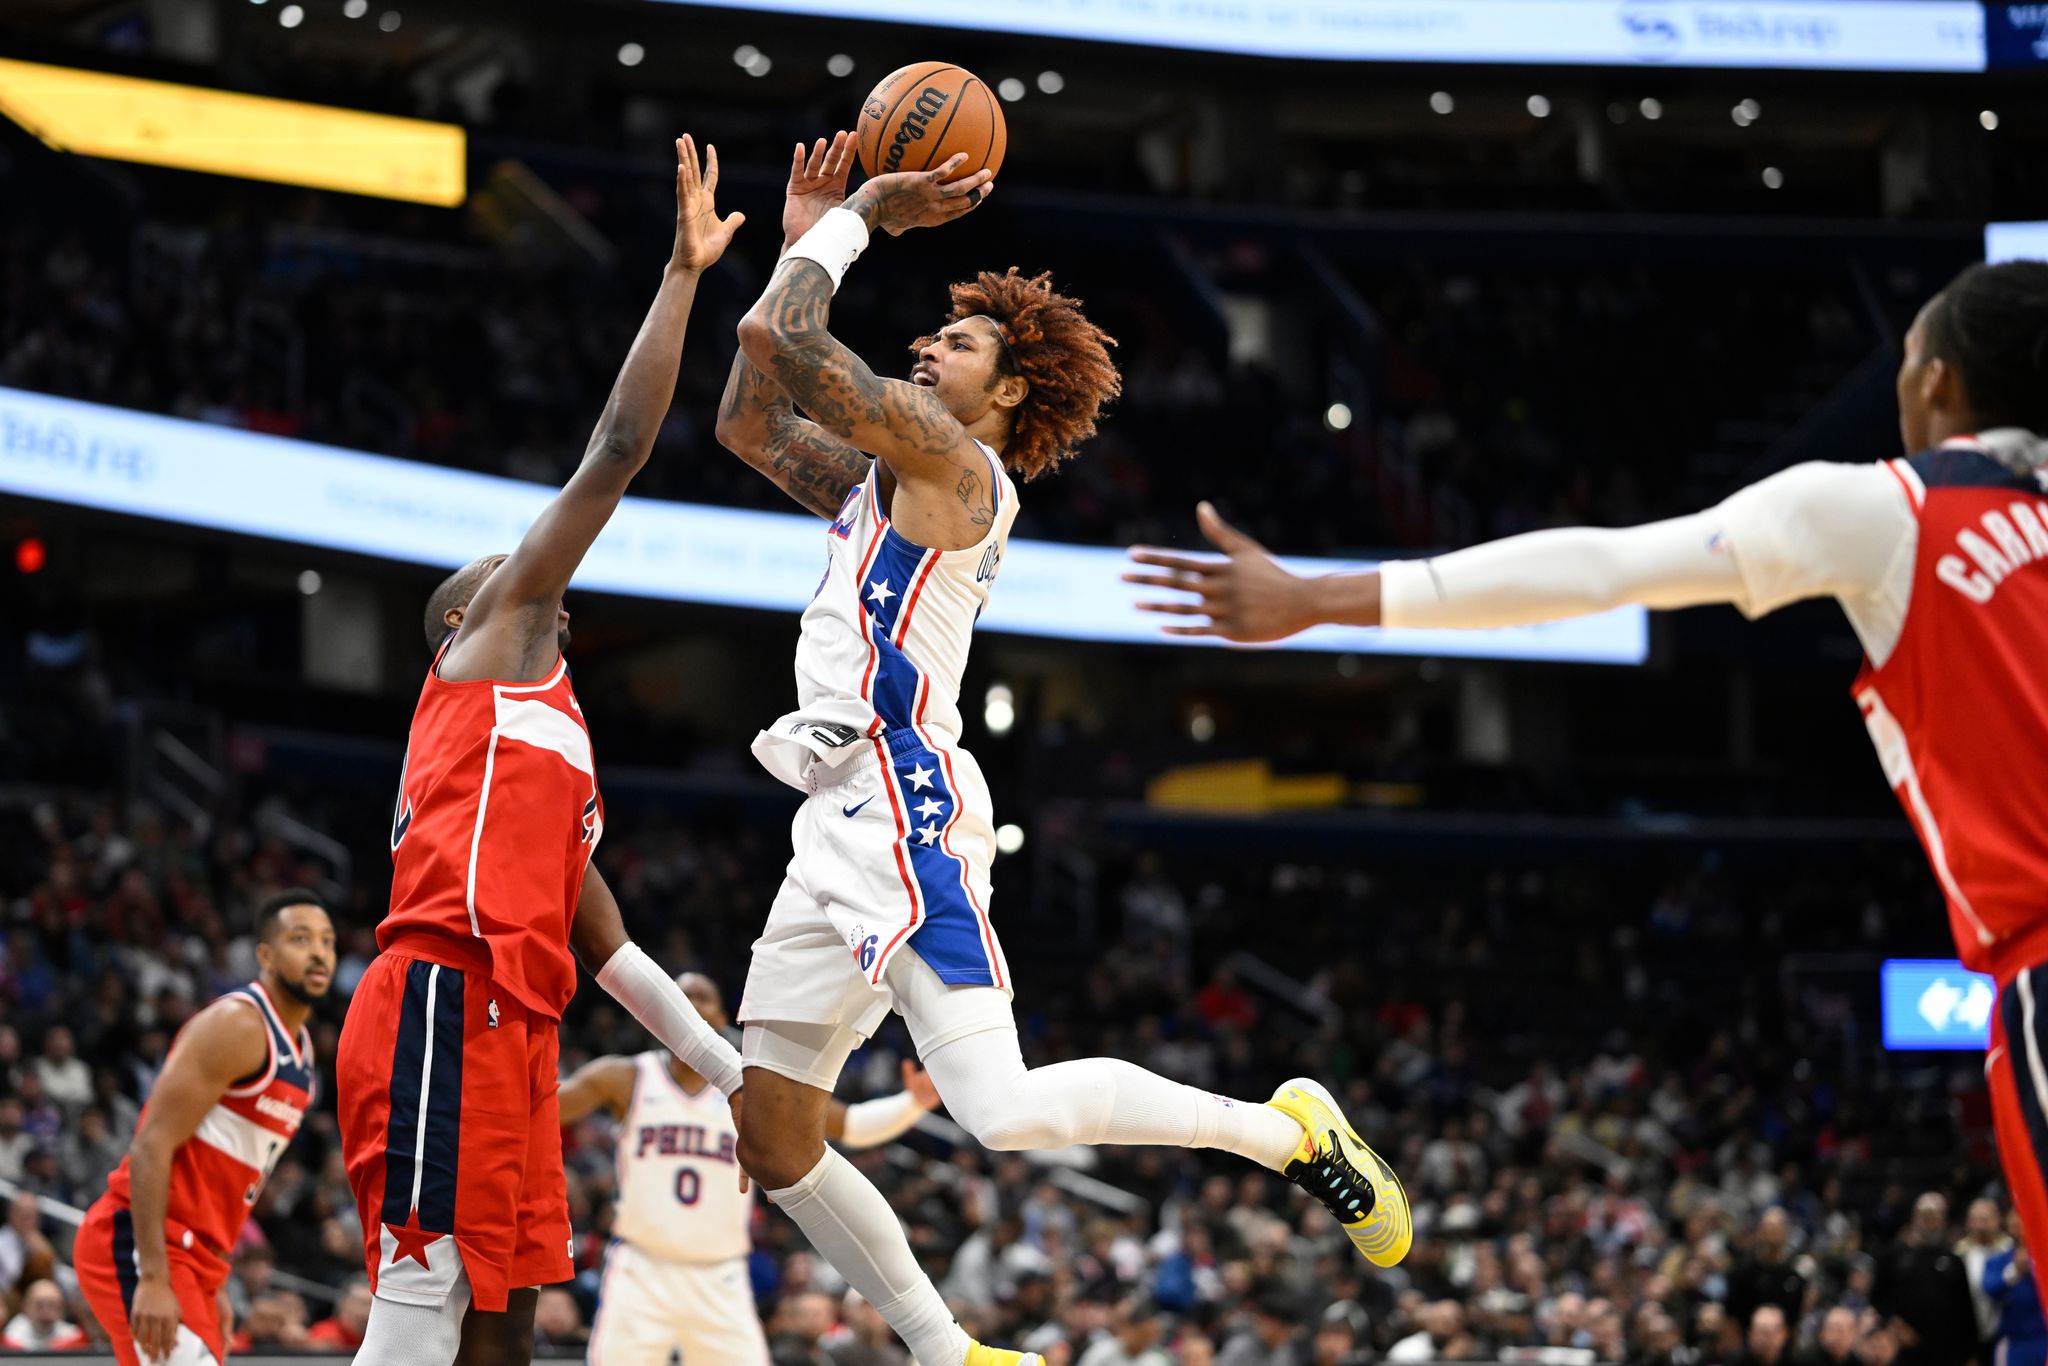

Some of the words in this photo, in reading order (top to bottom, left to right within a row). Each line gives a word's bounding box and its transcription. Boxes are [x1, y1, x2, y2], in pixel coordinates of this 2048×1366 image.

[882, 87, 950, 174] Wilson
[1936, 501, 2048, 604] CARR
[674, 1166, 701, 1206] 0
